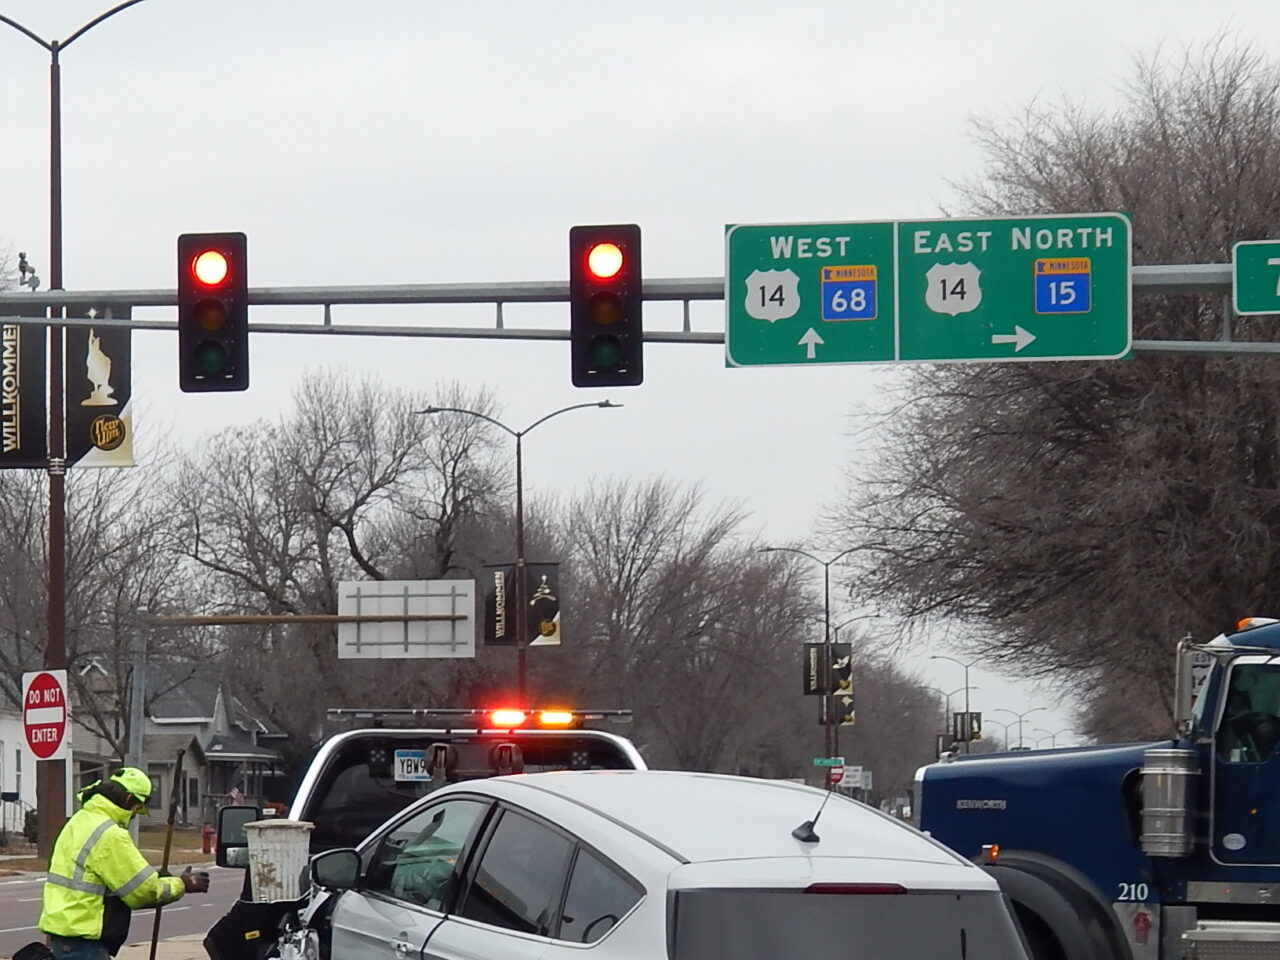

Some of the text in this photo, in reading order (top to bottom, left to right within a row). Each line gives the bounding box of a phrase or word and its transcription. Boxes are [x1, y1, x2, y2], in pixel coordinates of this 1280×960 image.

[770, 236, 851, 259] WEST
[914, 226, 1113, 254] EAST NORTH
[835, 268, 874, 278] MINNESOTA
[1049, 261, 1088, 271] MINNESOTA
[759, 285, 785, 307] 14
[831, 288, 867, 312] 68
[940, 278, 967, 301] 14
[1049, 281, 1076, 305] 15
[2, 324, 17, 453] WILLKOMME
[494, 571, 505, 638] WILLKOMMEN
[29, 688, 60, 704] DO NOT
[32, 728, 58, 743] ENTER
[1117, 882, 1149, 900] 210
